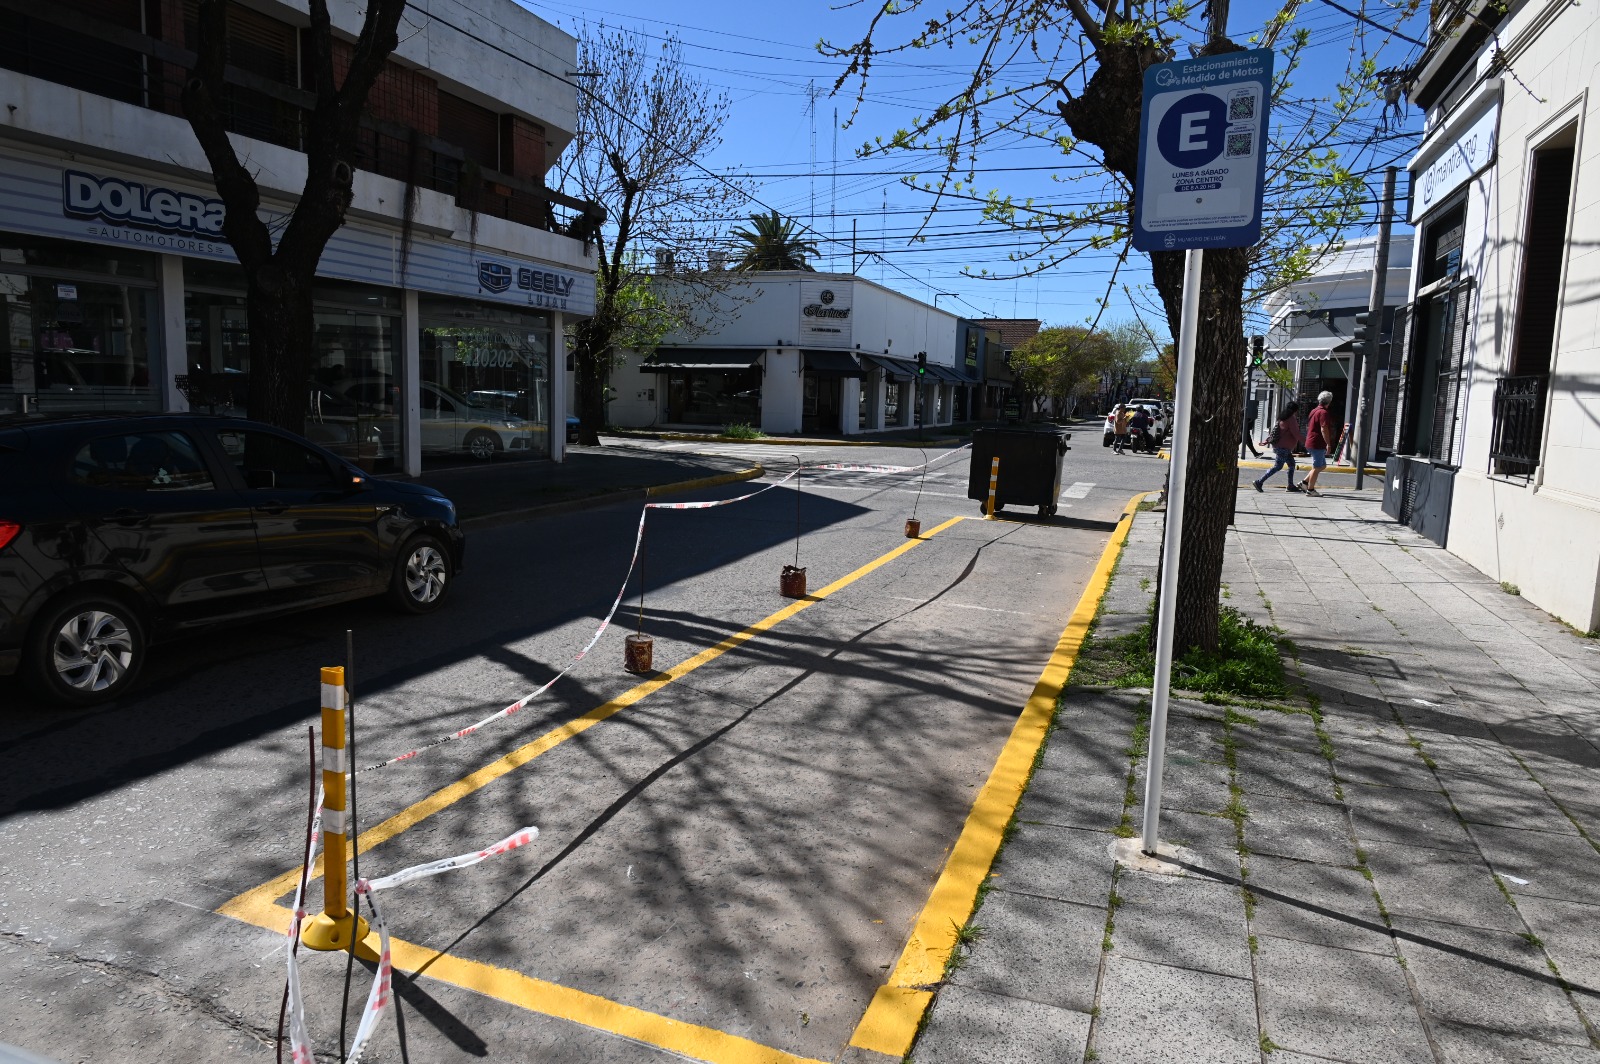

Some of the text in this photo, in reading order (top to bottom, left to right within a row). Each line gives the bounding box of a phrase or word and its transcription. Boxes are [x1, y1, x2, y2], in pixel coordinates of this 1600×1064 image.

[1183, 55, 1259, 74] Estacionamiento
[1181, 66, 1264, 85] Medido de Motos
[1178, 110, 1210, 152] E
[1172, 171, 1194, 179] LUNES
[1201, 168, 1229, 176] SÁBADO
[1195, 175, 1224, 184] CENTRO
[100, 226, 214, 253] AUTOMOTORES
[517, 267, 575, 297] GEELY
